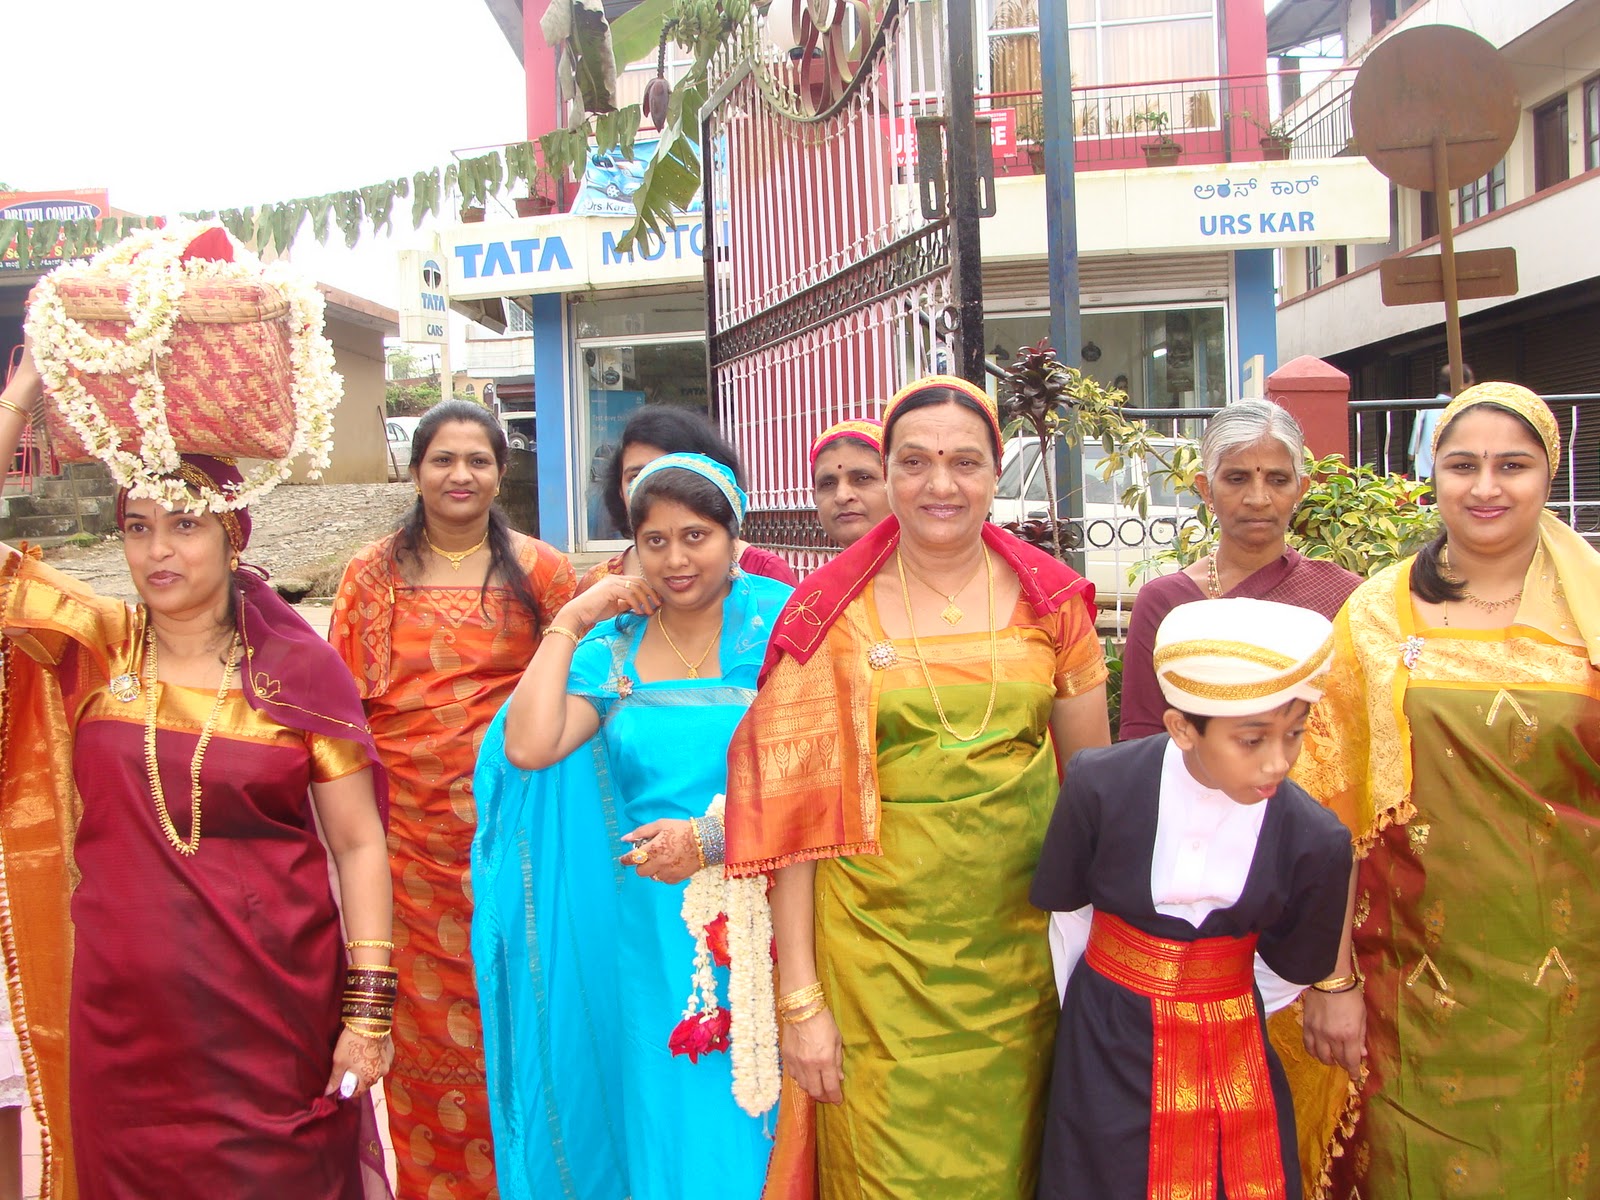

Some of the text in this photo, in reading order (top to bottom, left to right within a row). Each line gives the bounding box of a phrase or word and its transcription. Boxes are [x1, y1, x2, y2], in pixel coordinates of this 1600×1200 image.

[1270, 175, 1319, 195] ಕಾರ್
[1200, 211, 1315, 236] URS KAR
[455, 236, 573, 278] TATA
[421, 292, 446, 312] TATA
[427, 324, 443, 337] CARS
